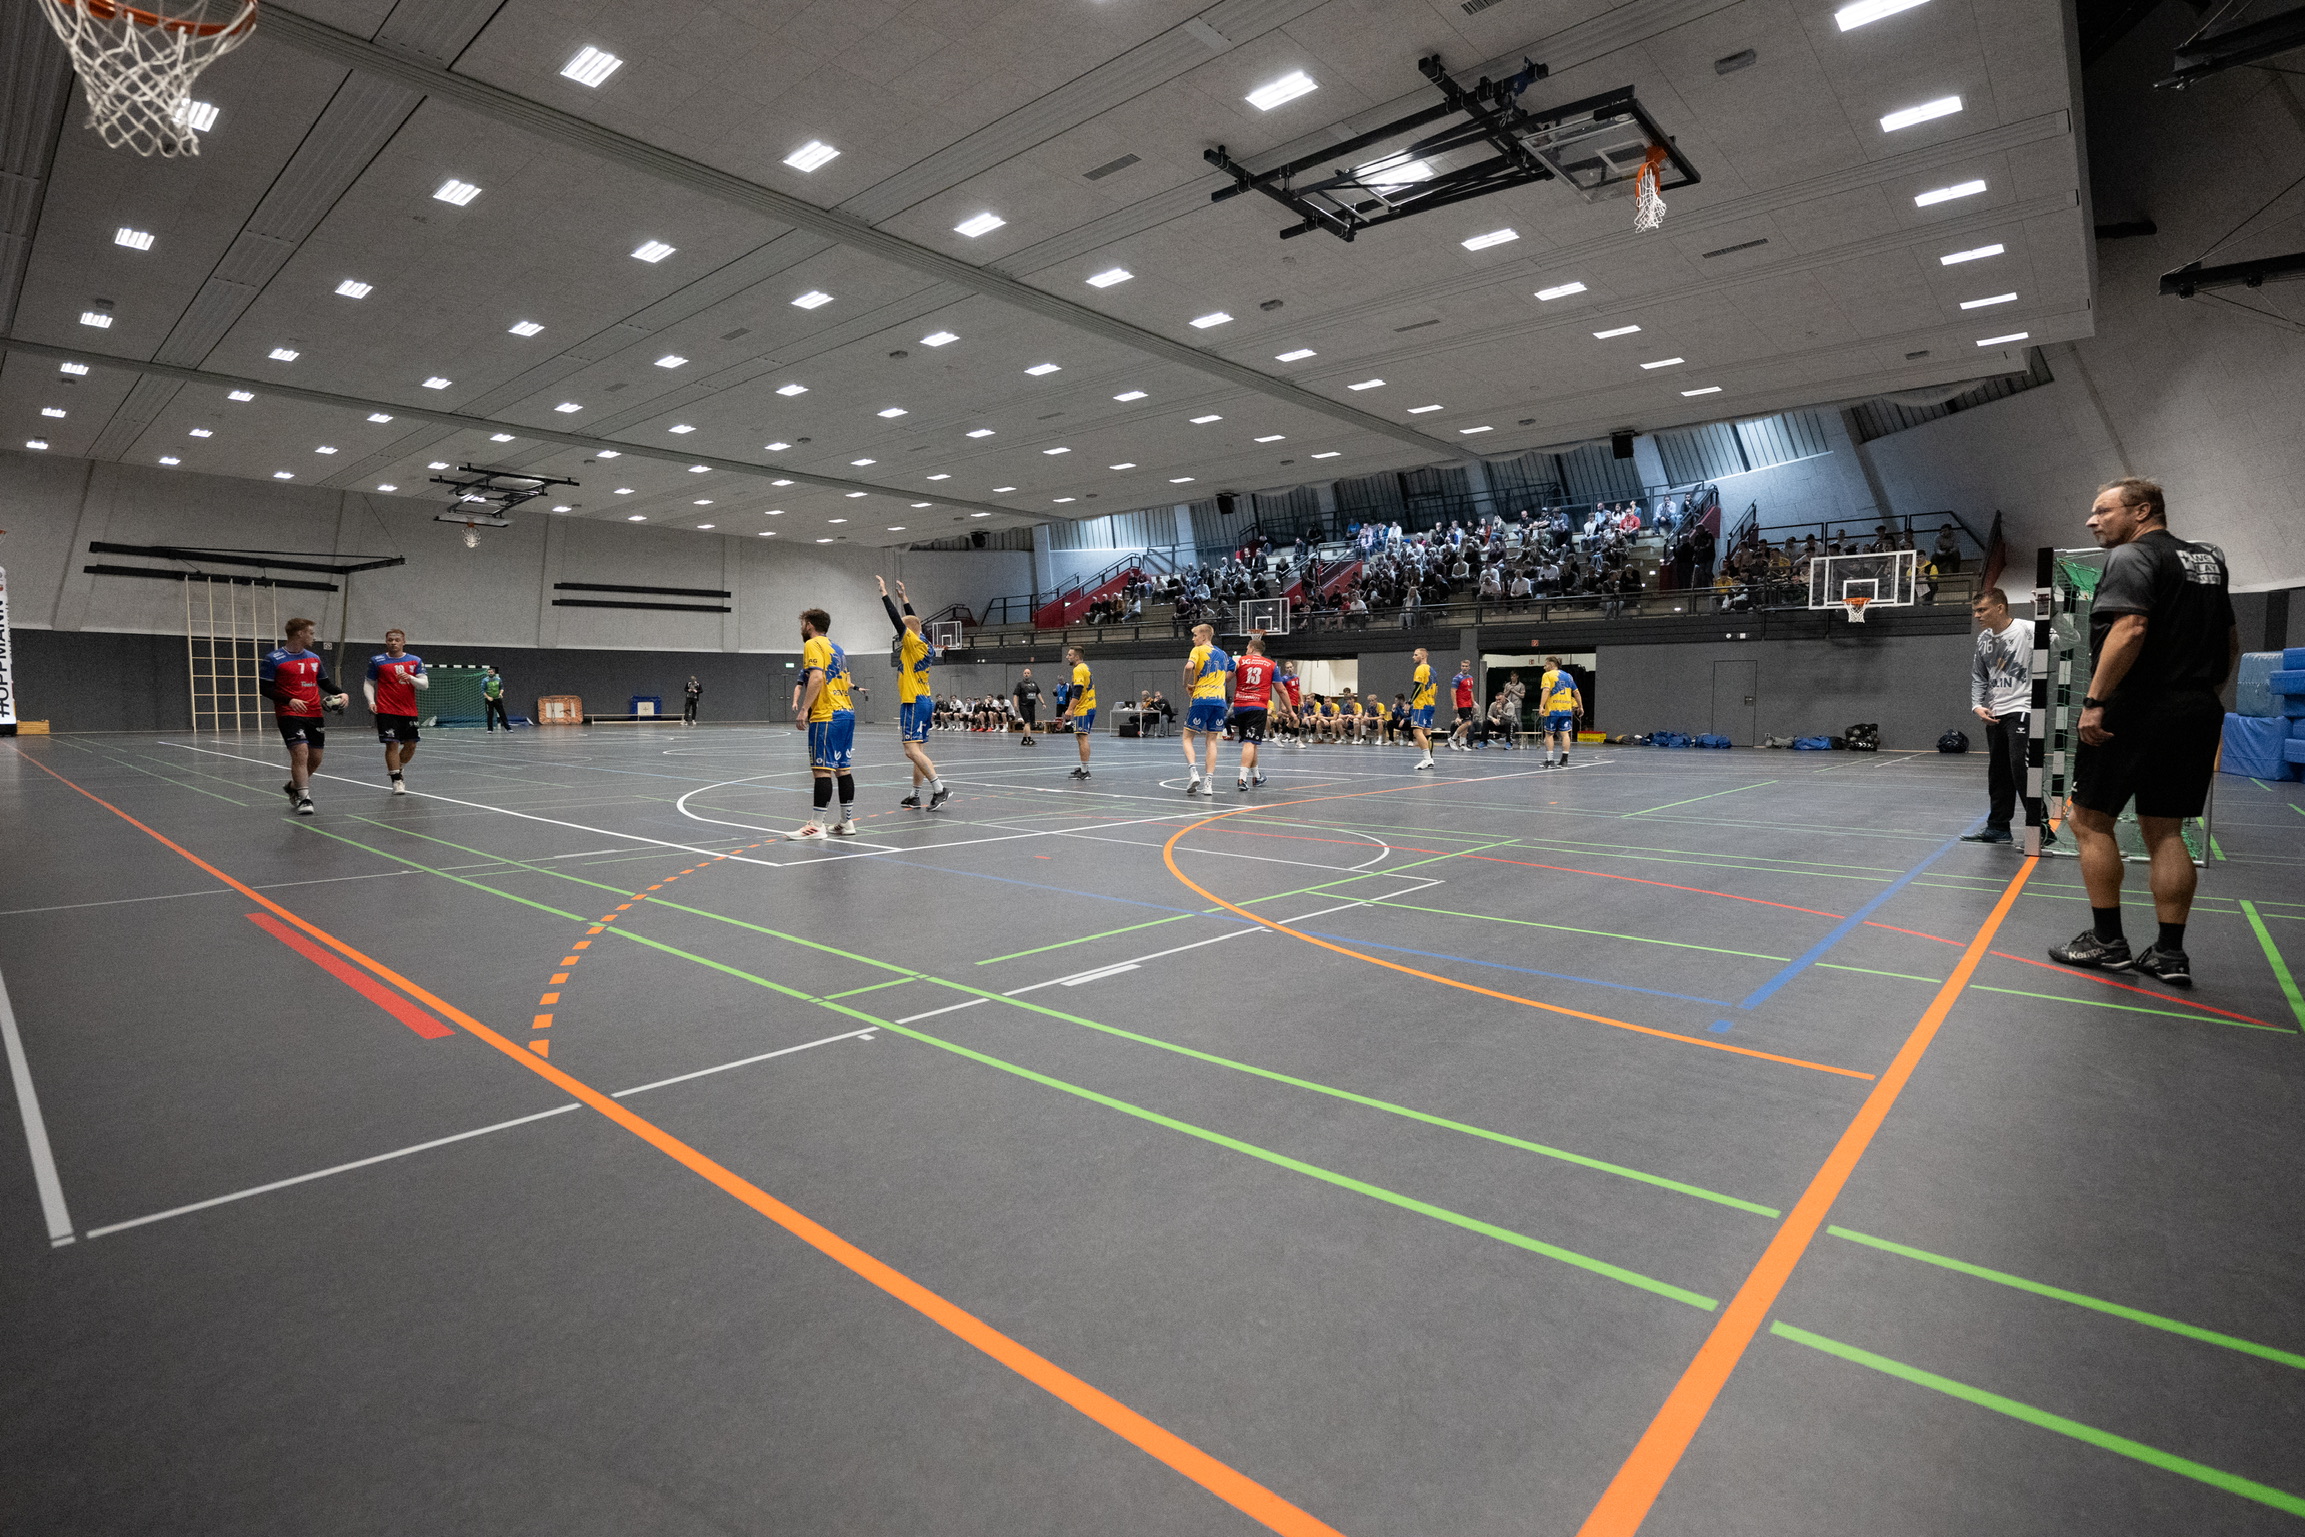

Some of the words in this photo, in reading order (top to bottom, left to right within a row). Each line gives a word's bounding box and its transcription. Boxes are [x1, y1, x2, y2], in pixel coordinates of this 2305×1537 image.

[1982, 639, 1993, 655] 16
[0, 600, 10, 717] #OPPM
[297, 662, 305, 674] 7
[1245, 667, 1262, 685] 13
